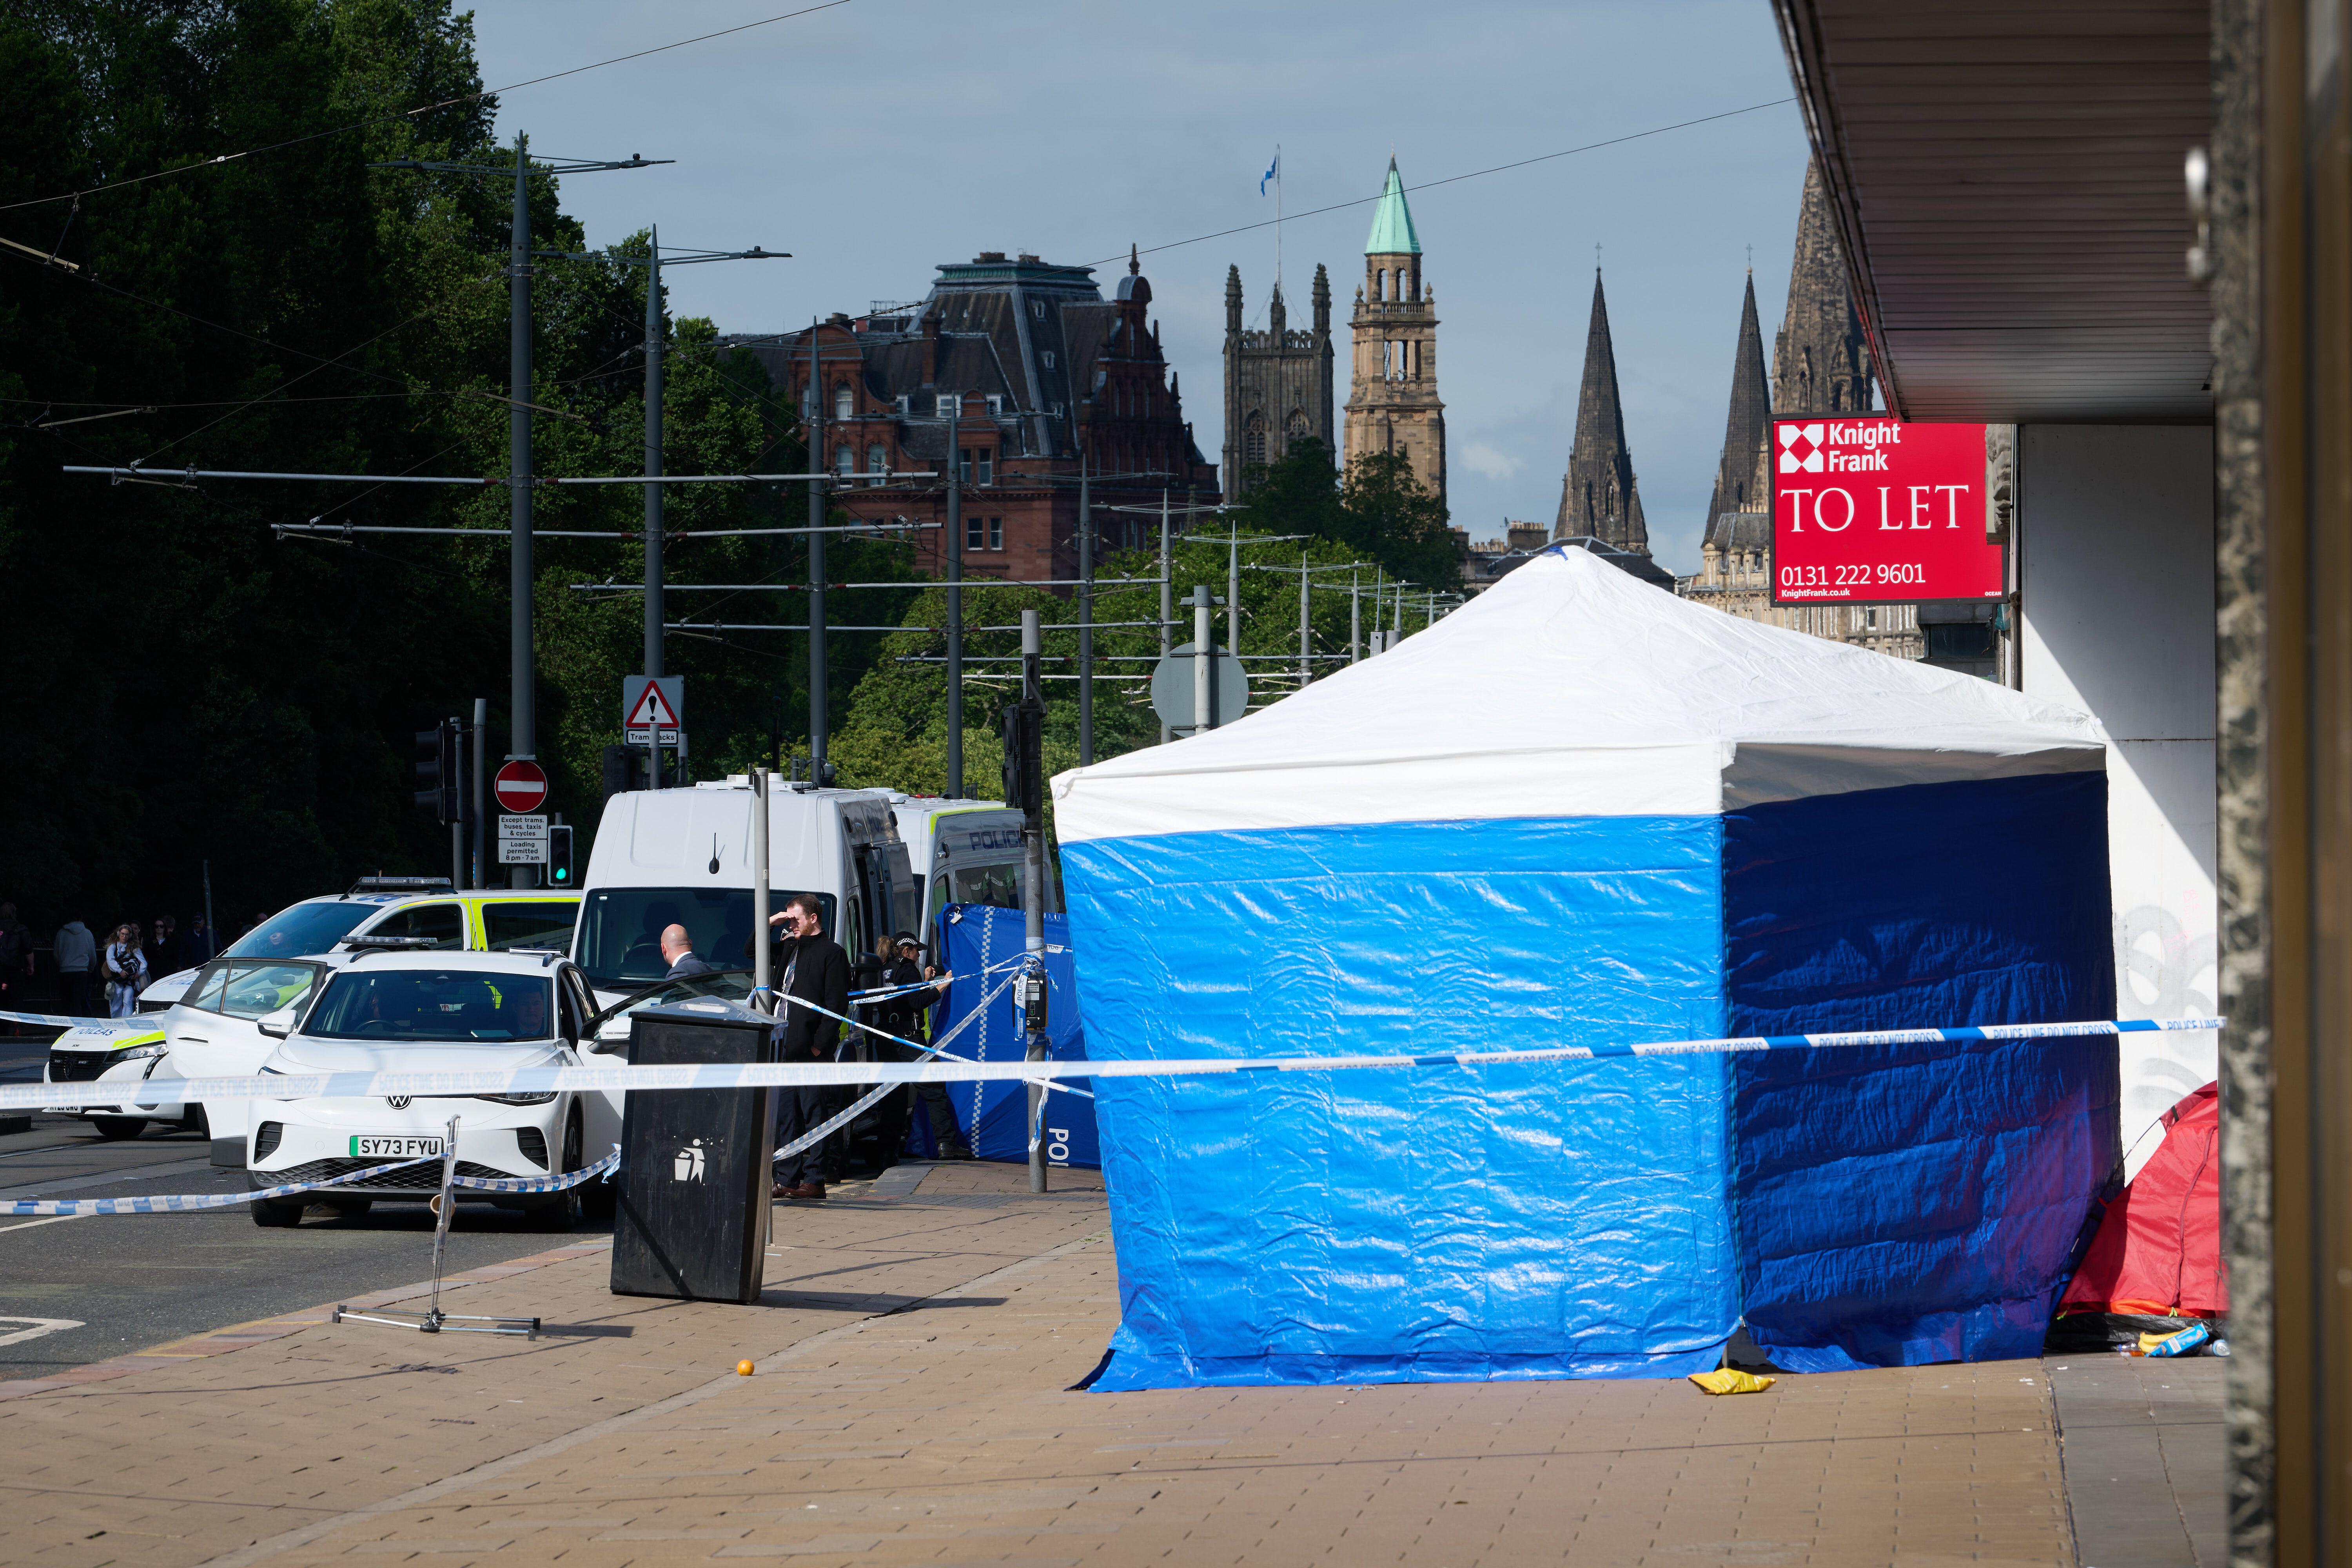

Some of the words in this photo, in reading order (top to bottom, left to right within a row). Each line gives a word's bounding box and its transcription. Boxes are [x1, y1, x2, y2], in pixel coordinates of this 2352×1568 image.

[1829, 422, 1900, 450] Knight
[1829, 449, 1889, 472] Frank
[1780, 488, 1854, 532] TO
[1877, 485, 1969, 530] LET
[1782, 566, 1829, 586] 0131
[1835, 565, 1871, 585] 222
[1877, 564, 1926, 583] 9601
[1782, 587, 1850, 599] KnightFrank.co.uk
[858, 995, 880, 1004] POLICE
[362, 1139, 402, 1154] SY73
[407, 1140, 438, 1155] FYU
